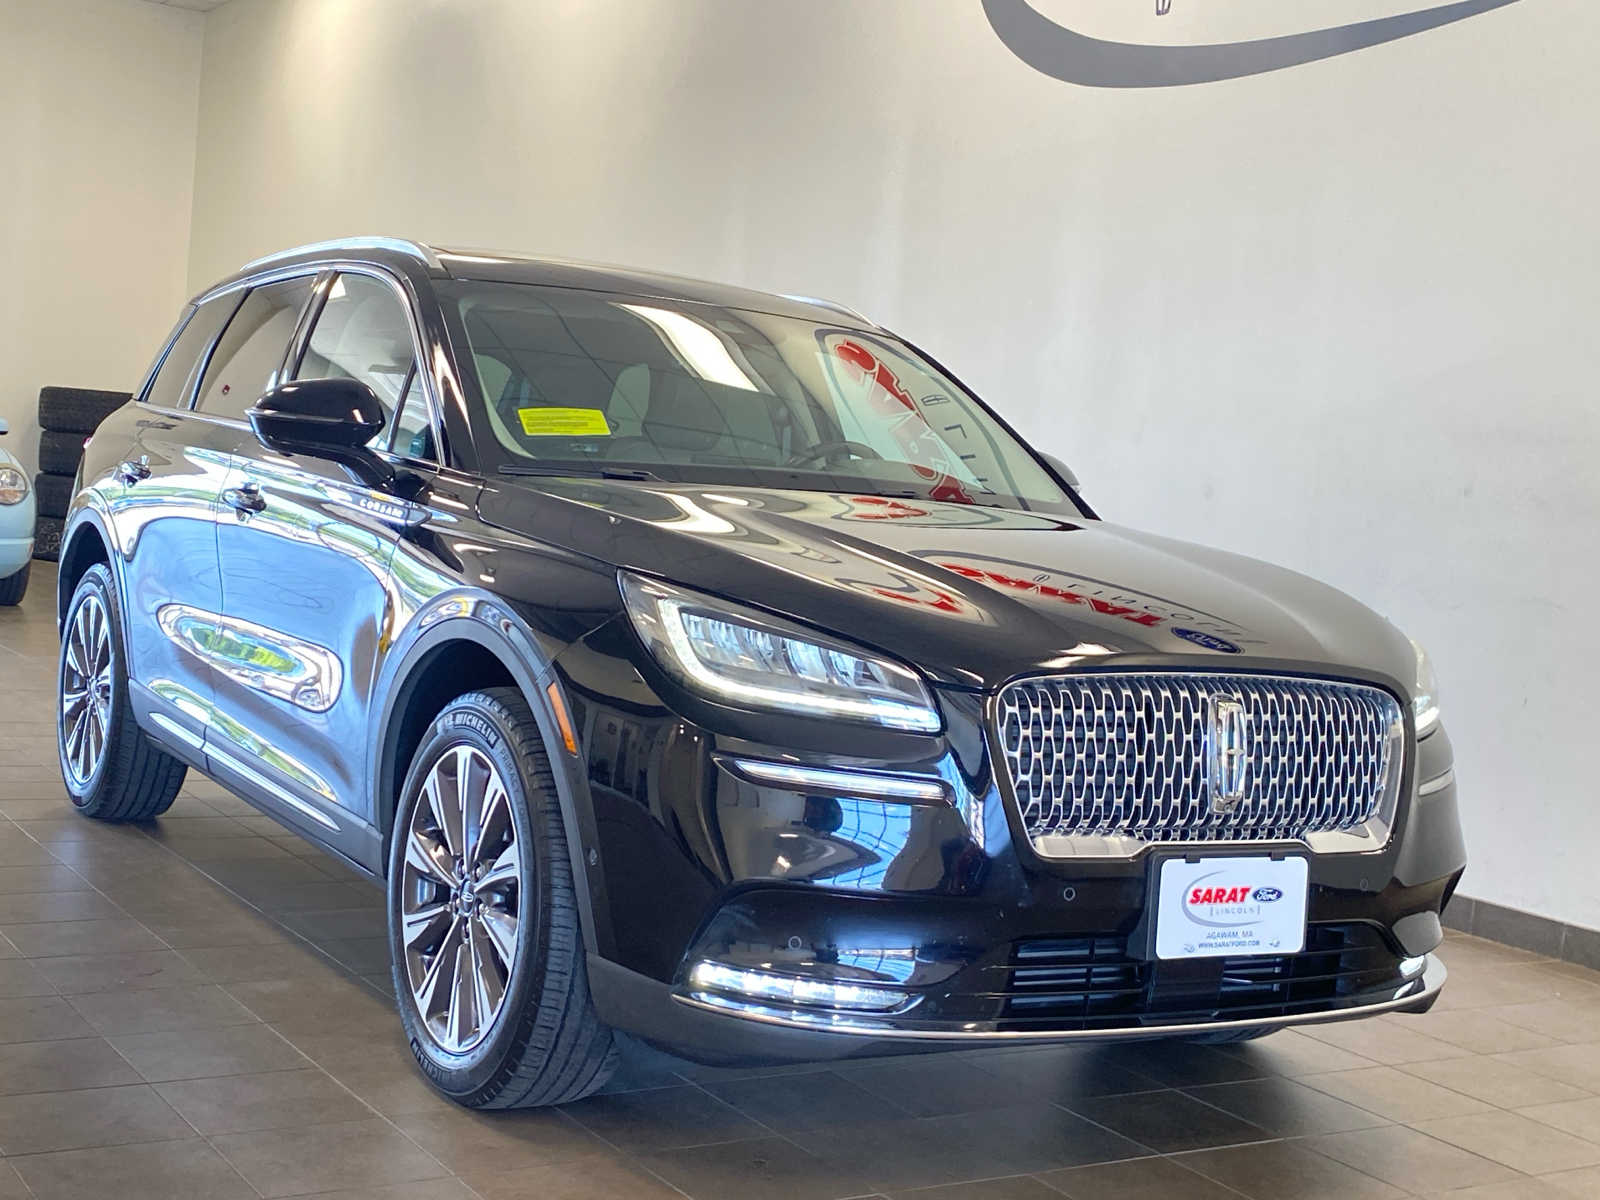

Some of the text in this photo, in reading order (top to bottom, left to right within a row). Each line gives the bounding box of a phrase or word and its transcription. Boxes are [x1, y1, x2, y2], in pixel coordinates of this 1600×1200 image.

[454, 713, 498, 745] MICHELIN
[500, 748, 520, 793] PRIMACY
[1188, 886, 1281, 905] SARAT Ford
[1216, 906, 1255, 916] LINCOLN
[1198, 940, 1261, 949] WWW.SARATFORD.COM
[1206, 930, 1254, 940] AGAWAM, MA
[410, 1041, 451, 1081] MICHELIN
